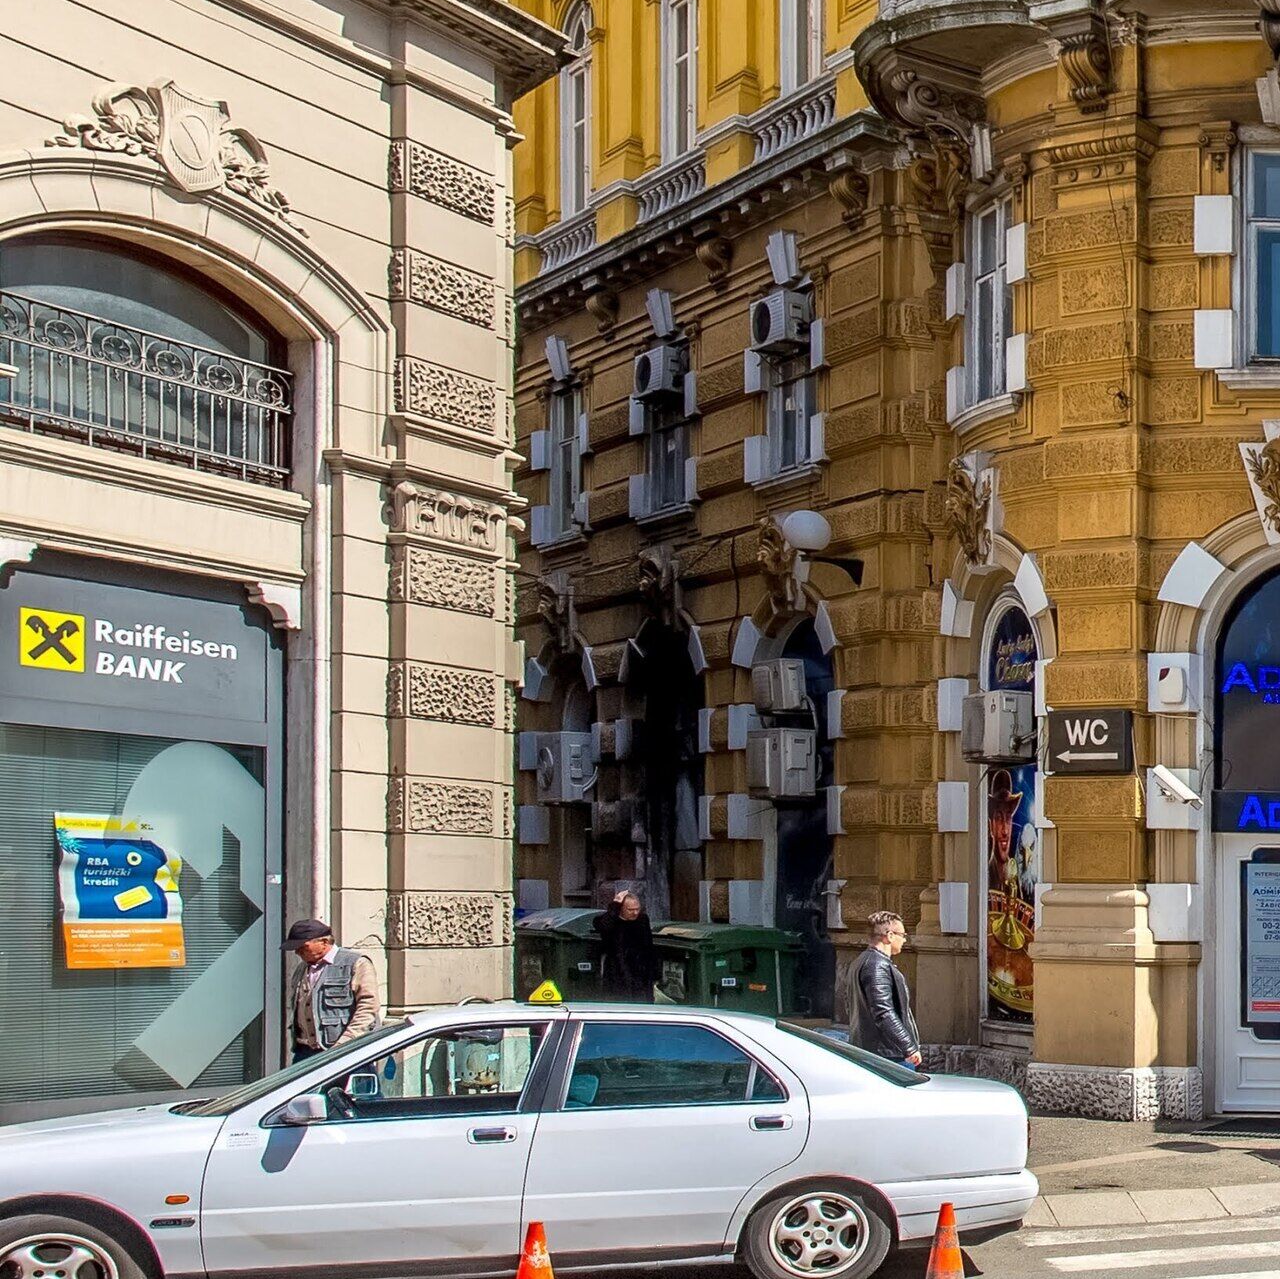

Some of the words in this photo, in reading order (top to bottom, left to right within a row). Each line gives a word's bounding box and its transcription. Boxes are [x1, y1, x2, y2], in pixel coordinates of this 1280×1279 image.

[94, 619, 238, 660] Raiffeisen
[95, 651, 186, 684] BANK
[1065, 719, 1109, 746] WC
[87, 857, 109, 866] RBA
[83, 867, 132, 877] turistički
[83, 877, 119, 887] krediti
